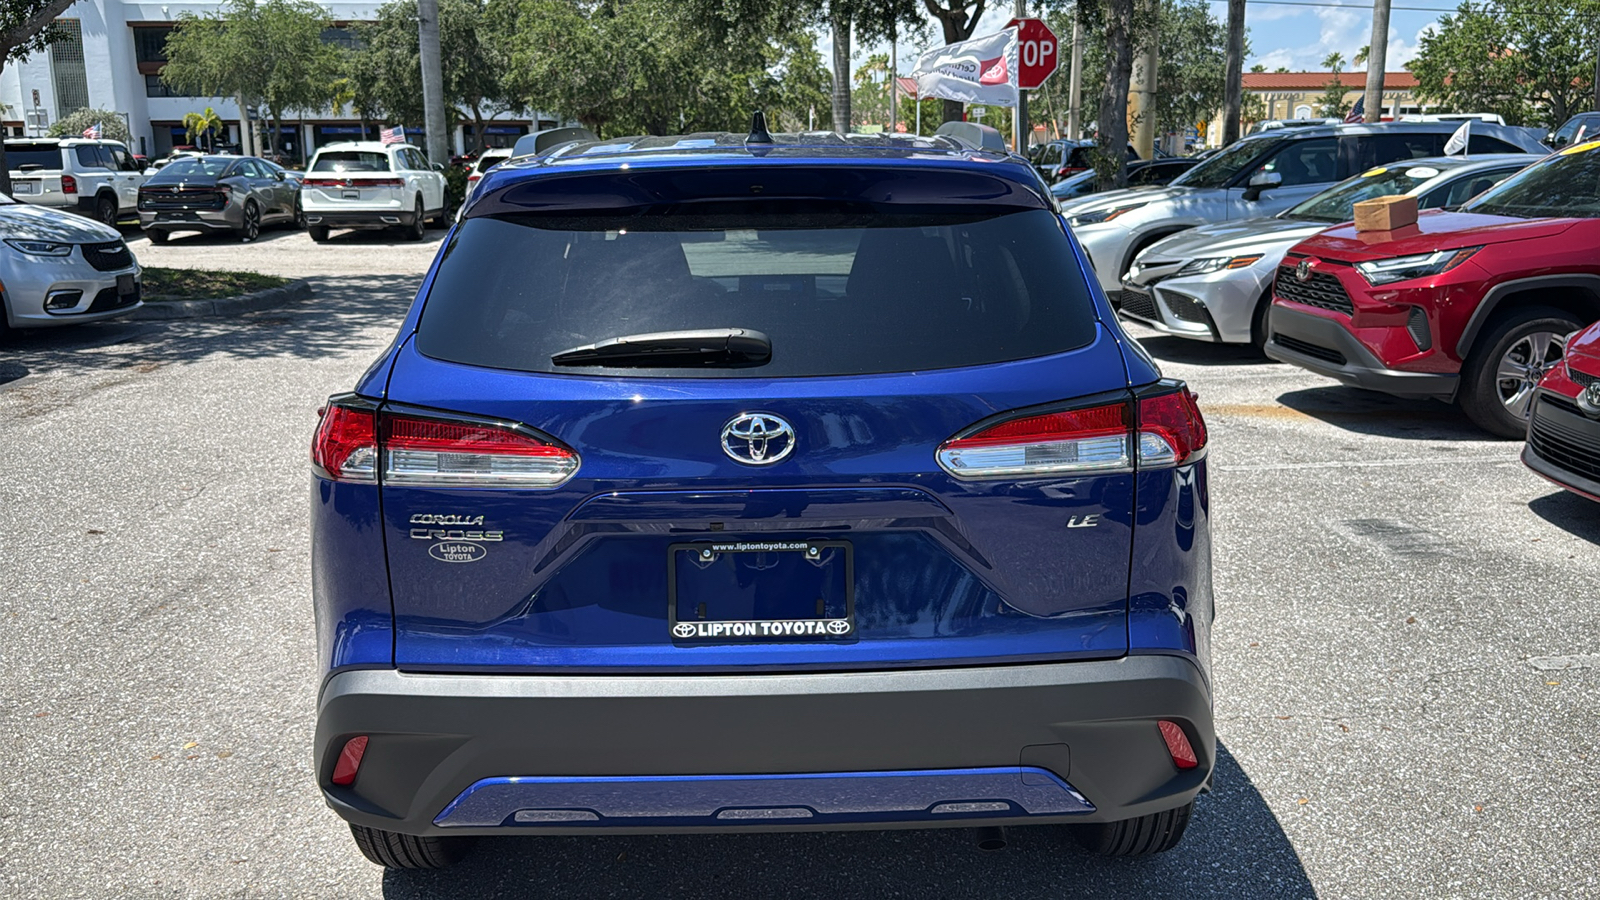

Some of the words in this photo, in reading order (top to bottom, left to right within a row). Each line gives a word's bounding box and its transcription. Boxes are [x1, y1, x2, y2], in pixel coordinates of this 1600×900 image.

[1018, 40, 1054, 67] OP
[409, 513, 484, 525] COROLLA
[1066, 513, 1100, 528] LE
[409, 528, 503, 541] CROSS
[440, 544, 475, 554] Lipton
[712, 542, 808, 551] www.liptontoyota.com
[698, 622, 756, 636] LIPTON
[761, 621, 826, 635] TOYOTA
